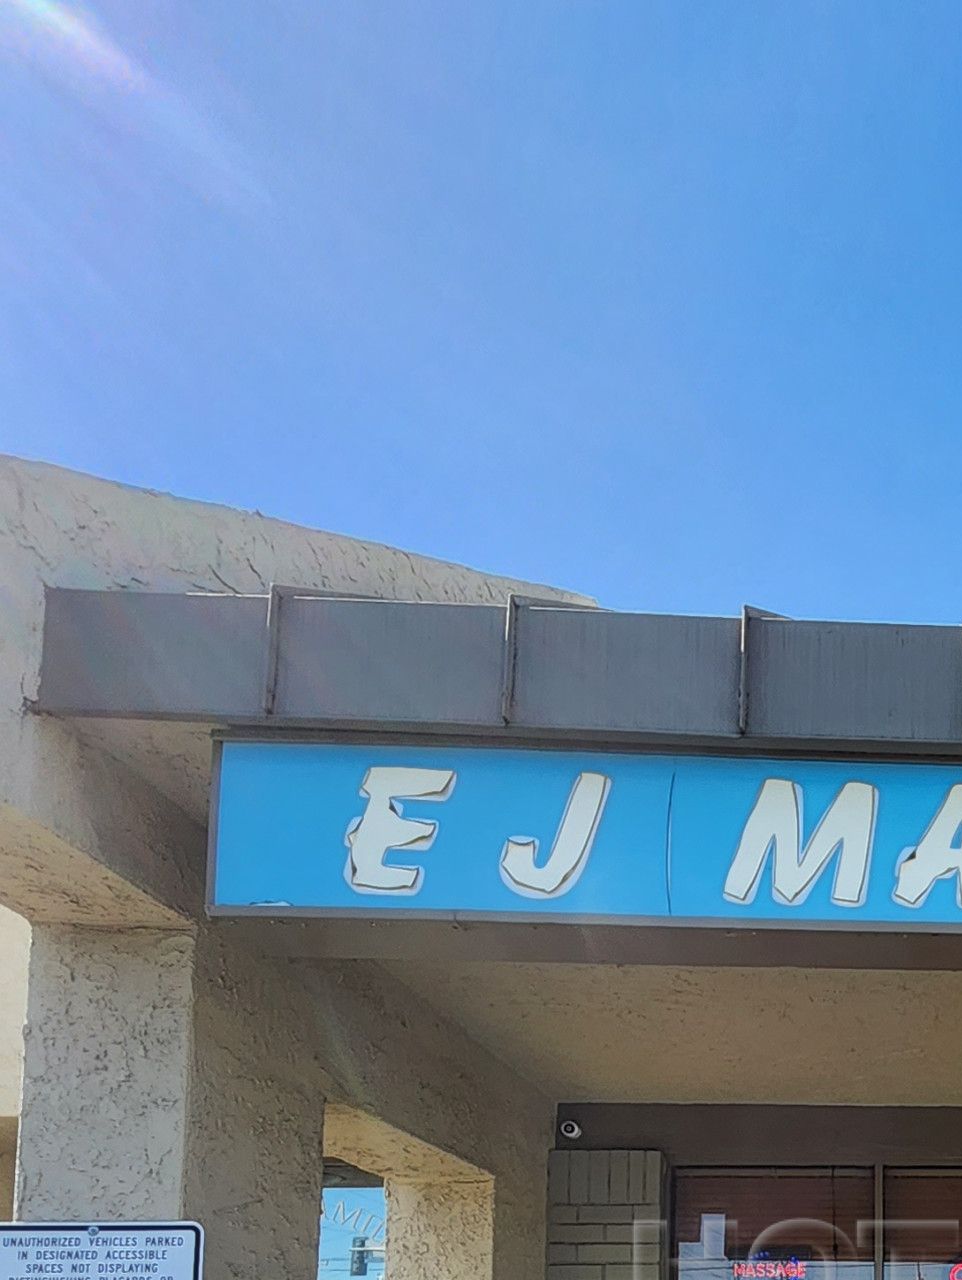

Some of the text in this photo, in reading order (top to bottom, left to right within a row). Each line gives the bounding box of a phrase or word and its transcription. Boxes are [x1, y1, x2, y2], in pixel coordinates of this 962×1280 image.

[3, 1237, 184, 1247] UNAUTHORIZED VEHICLES PARKED
[18, 1250, 167, 1260] IN DESIGNATED ACCESSIBLE
[25, 1263, 159, 1273] SPACES NOT DISPLAYING
[732, 1261, 807, 1279] MASSAGE
